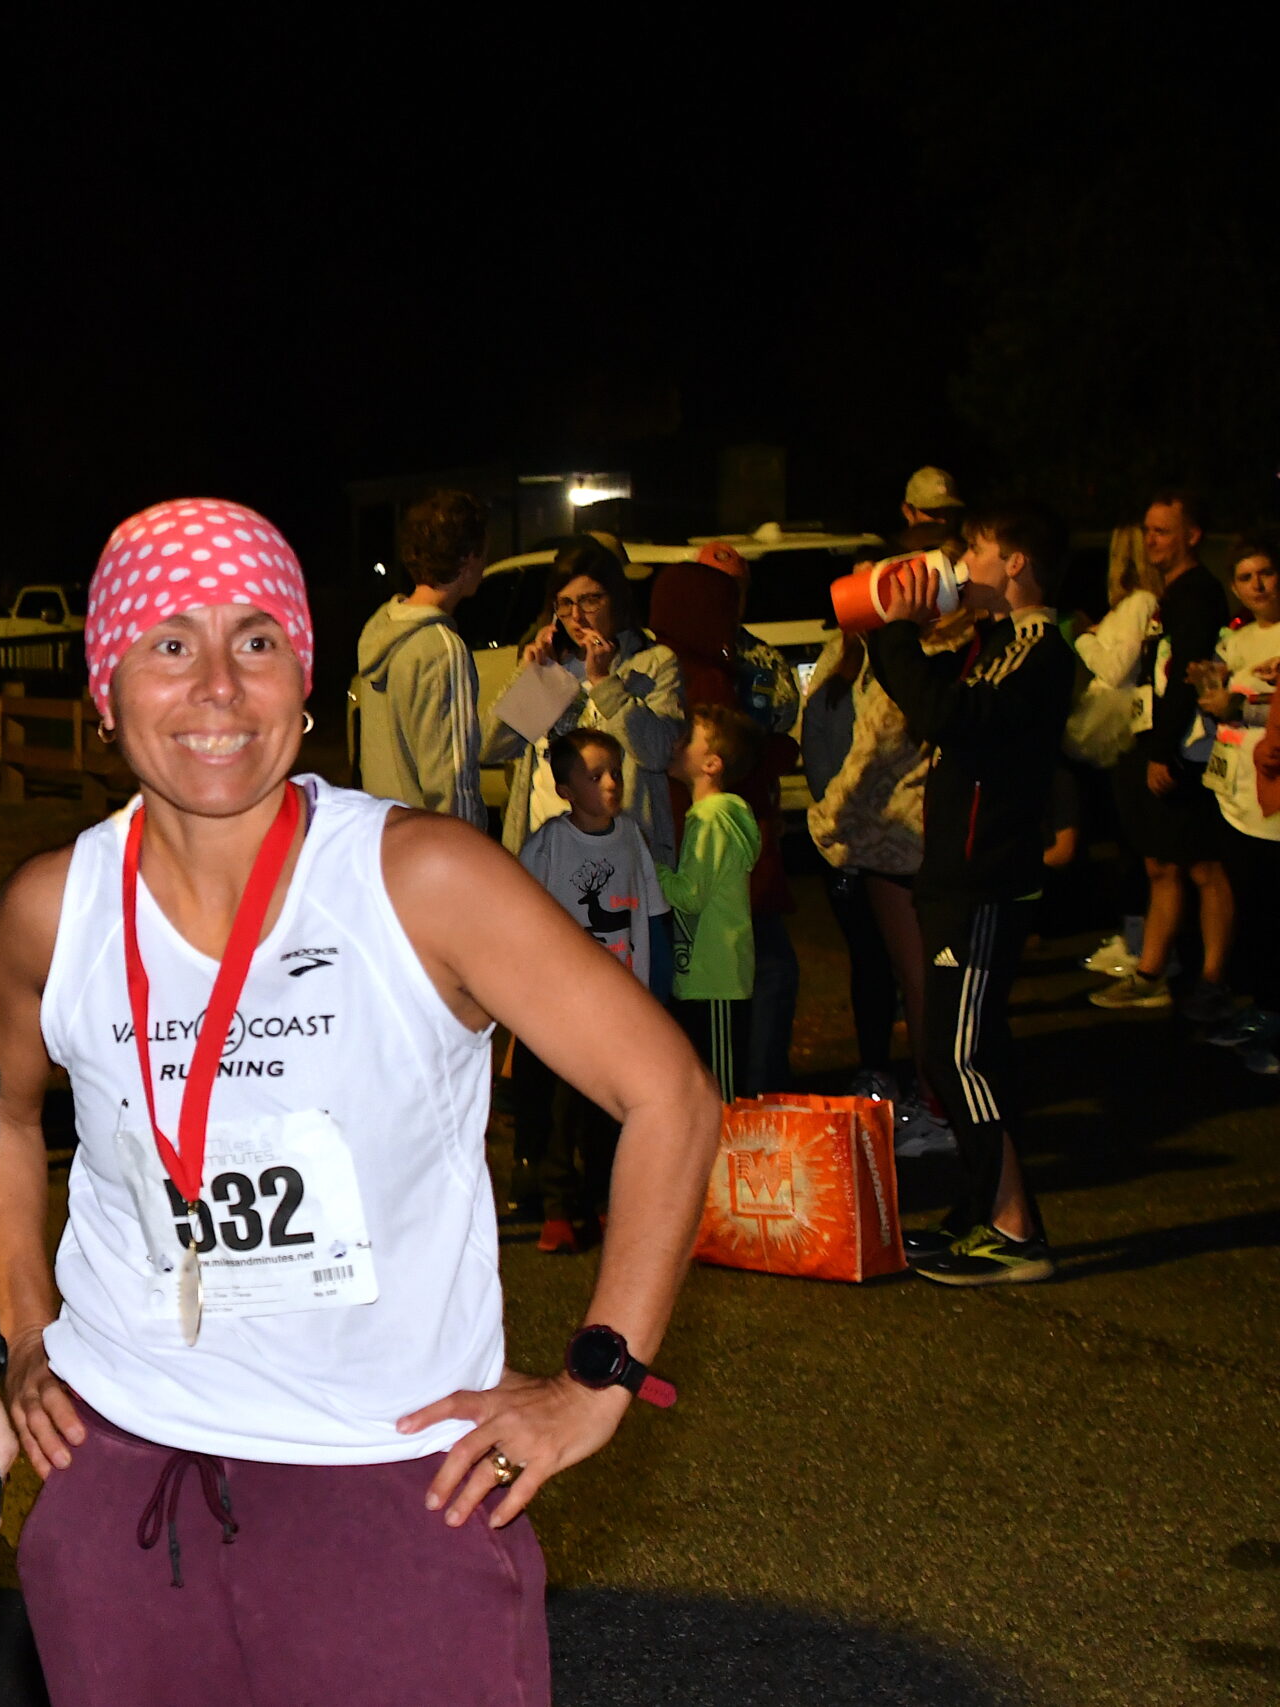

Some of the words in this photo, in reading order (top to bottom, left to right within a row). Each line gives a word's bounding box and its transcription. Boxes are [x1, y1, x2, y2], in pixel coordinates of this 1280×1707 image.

[112, 1019, 195, 1044] VALEY
[248, 1014, 336, 1039] COAST
[160, 1060, 285, 1081] RUNING
[163, 1165, 316, 1254] 532
